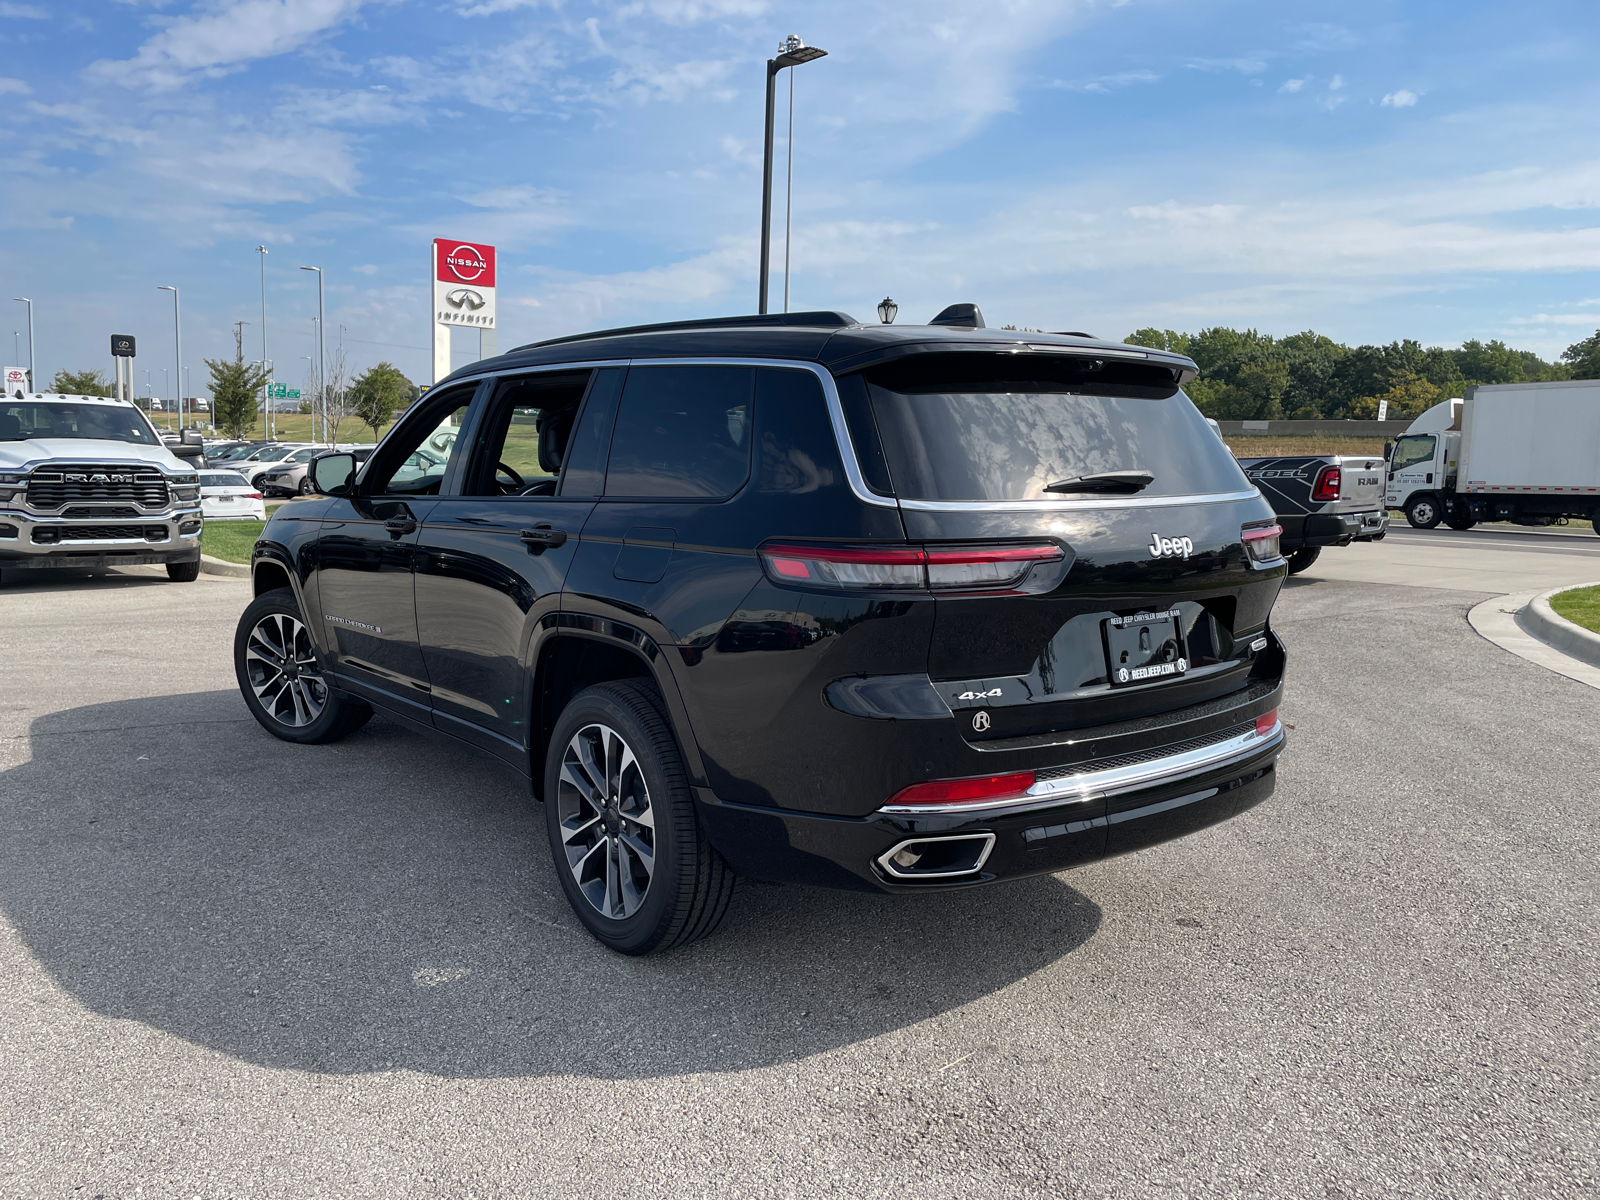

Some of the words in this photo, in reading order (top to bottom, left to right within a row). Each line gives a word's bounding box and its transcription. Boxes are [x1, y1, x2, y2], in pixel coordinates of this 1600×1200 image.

[447, 257, 486, 268] NISSAN
[438, 311, 494, 325] INFINITI
[65, 474, 134, 483] RAM
[1358, 477, 1379, 486] RAM
[1148, 532, 1193, 561] Jeep
[1110, 617, 1122, 625] REED
[1123, 615, 1134, 624] JEEP
[1134, 612, 1156, 622] CHRYSLER
[1156, 610, 1170, 619] DODGE
[1170, 609, 1180, 617] RAM
[1131, 663, 1175, 680] REEDJEEP.COM
[958, 688, 1003, 700] 4x4
